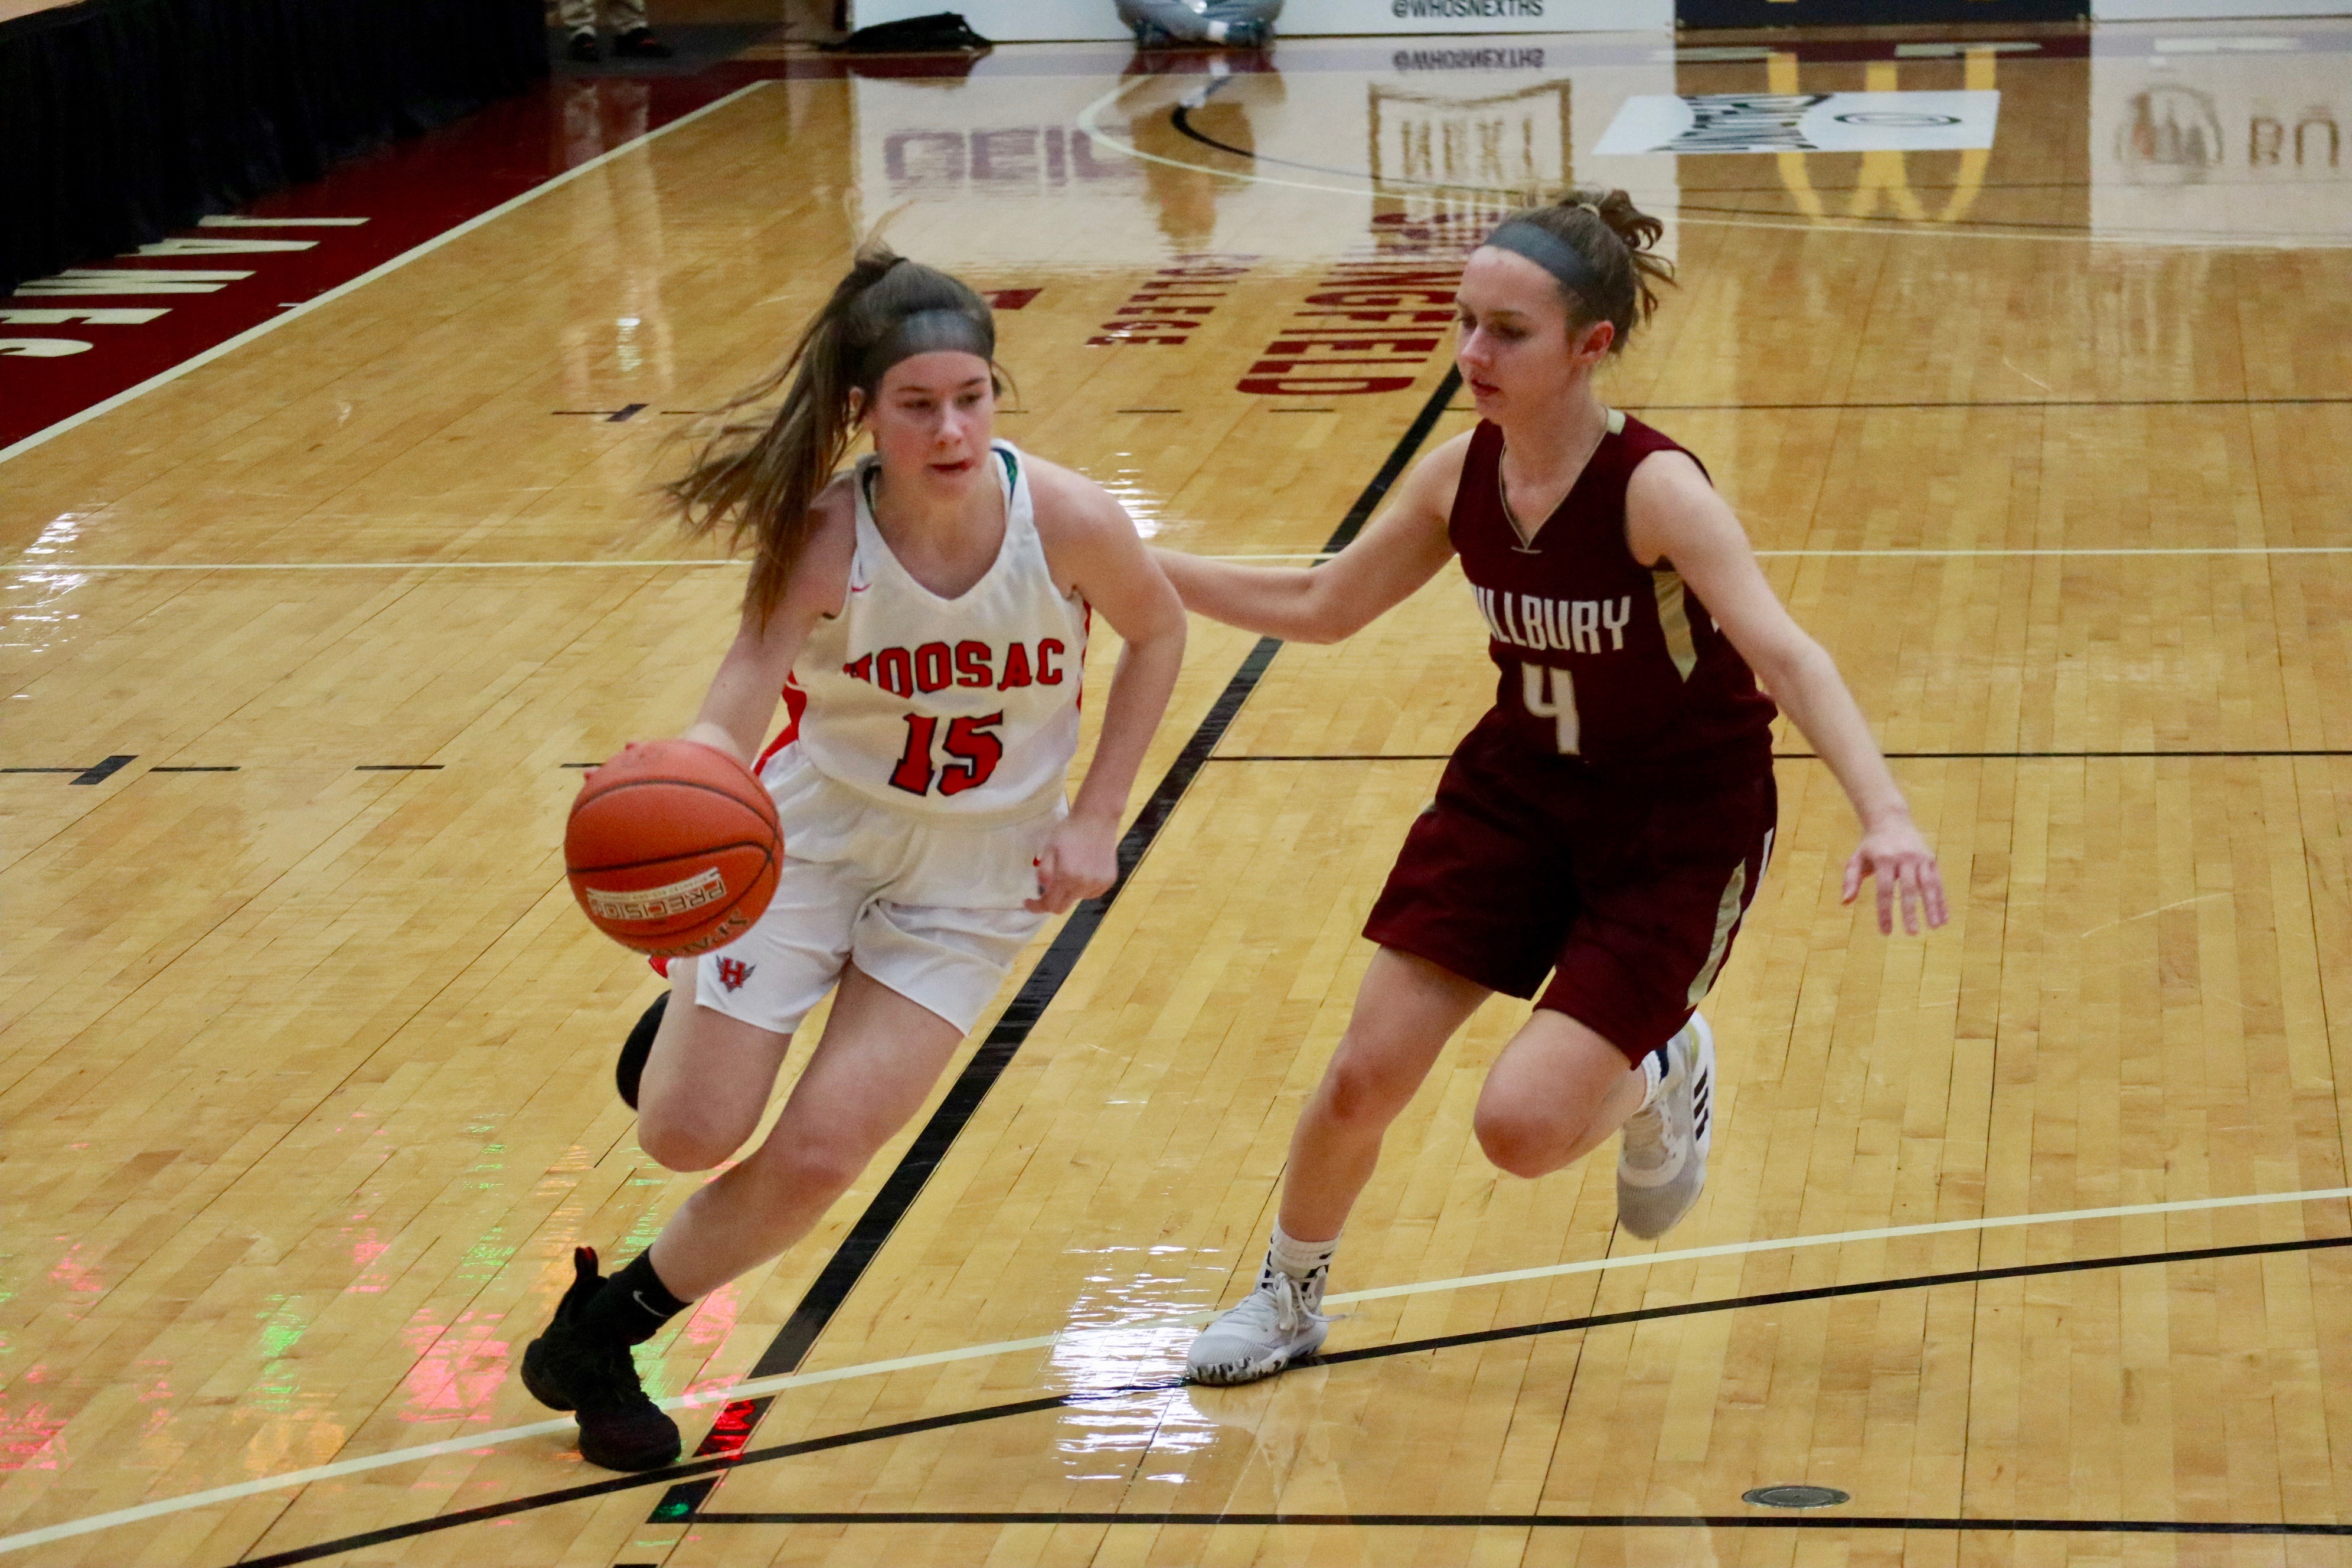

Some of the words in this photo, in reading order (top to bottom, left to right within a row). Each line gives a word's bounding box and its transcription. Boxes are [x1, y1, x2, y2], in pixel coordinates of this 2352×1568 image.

[1391, 0, 1545, 18] @WHOSNEXTHS
[1471, 583, 1632, 654] ILLBURY
[1520, 661, 1582, 756] 4
[887, 708, 1004, 797] 15
